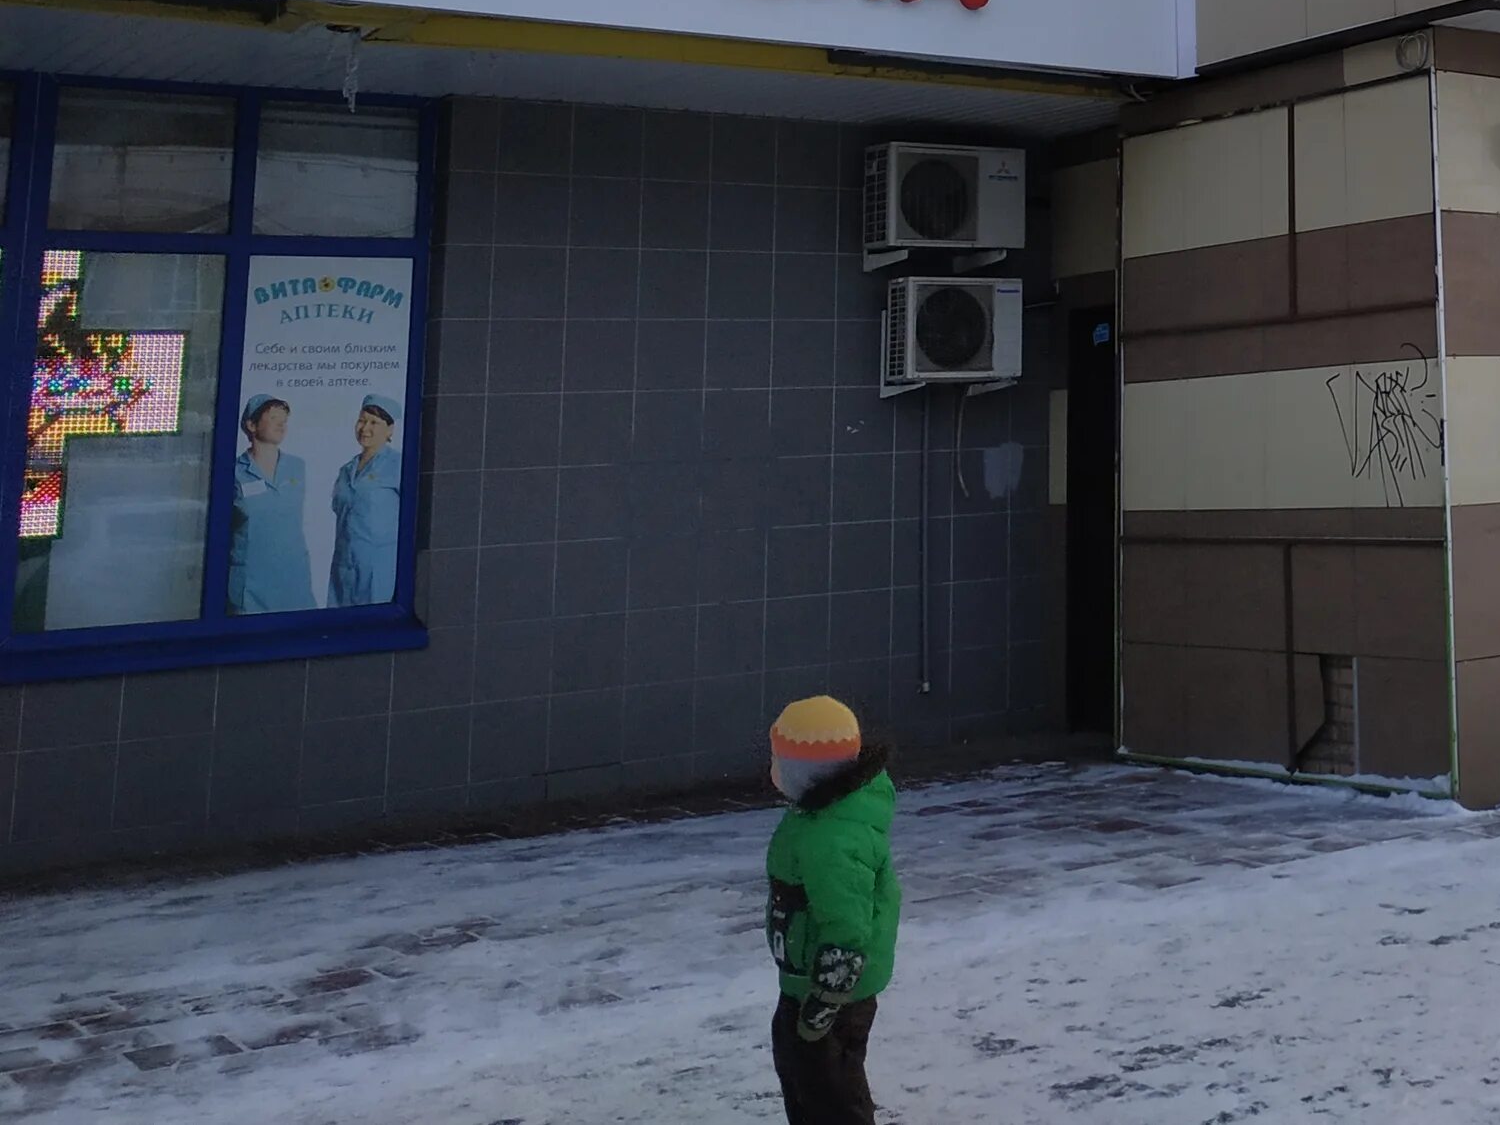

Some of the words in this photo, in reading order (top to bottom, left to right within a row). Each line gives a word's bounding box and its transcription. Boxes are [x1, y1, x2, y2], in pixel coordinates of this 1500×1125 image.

[280, 303, 375, 324] АПТЕКИ
[255, 343, 285, 354] Себе
[290, 346, 297, 354] и
[302, 346, 340, 354] своим
[344, 342, 396, 354] близким
[249, 363, 312, 371] лекарства
[340, 361, 400, 372] покупаем
[276, 379, 283, 387] в
[287, 376, 324, 387] своей
[328, 378, 371, 387] аптеке.
